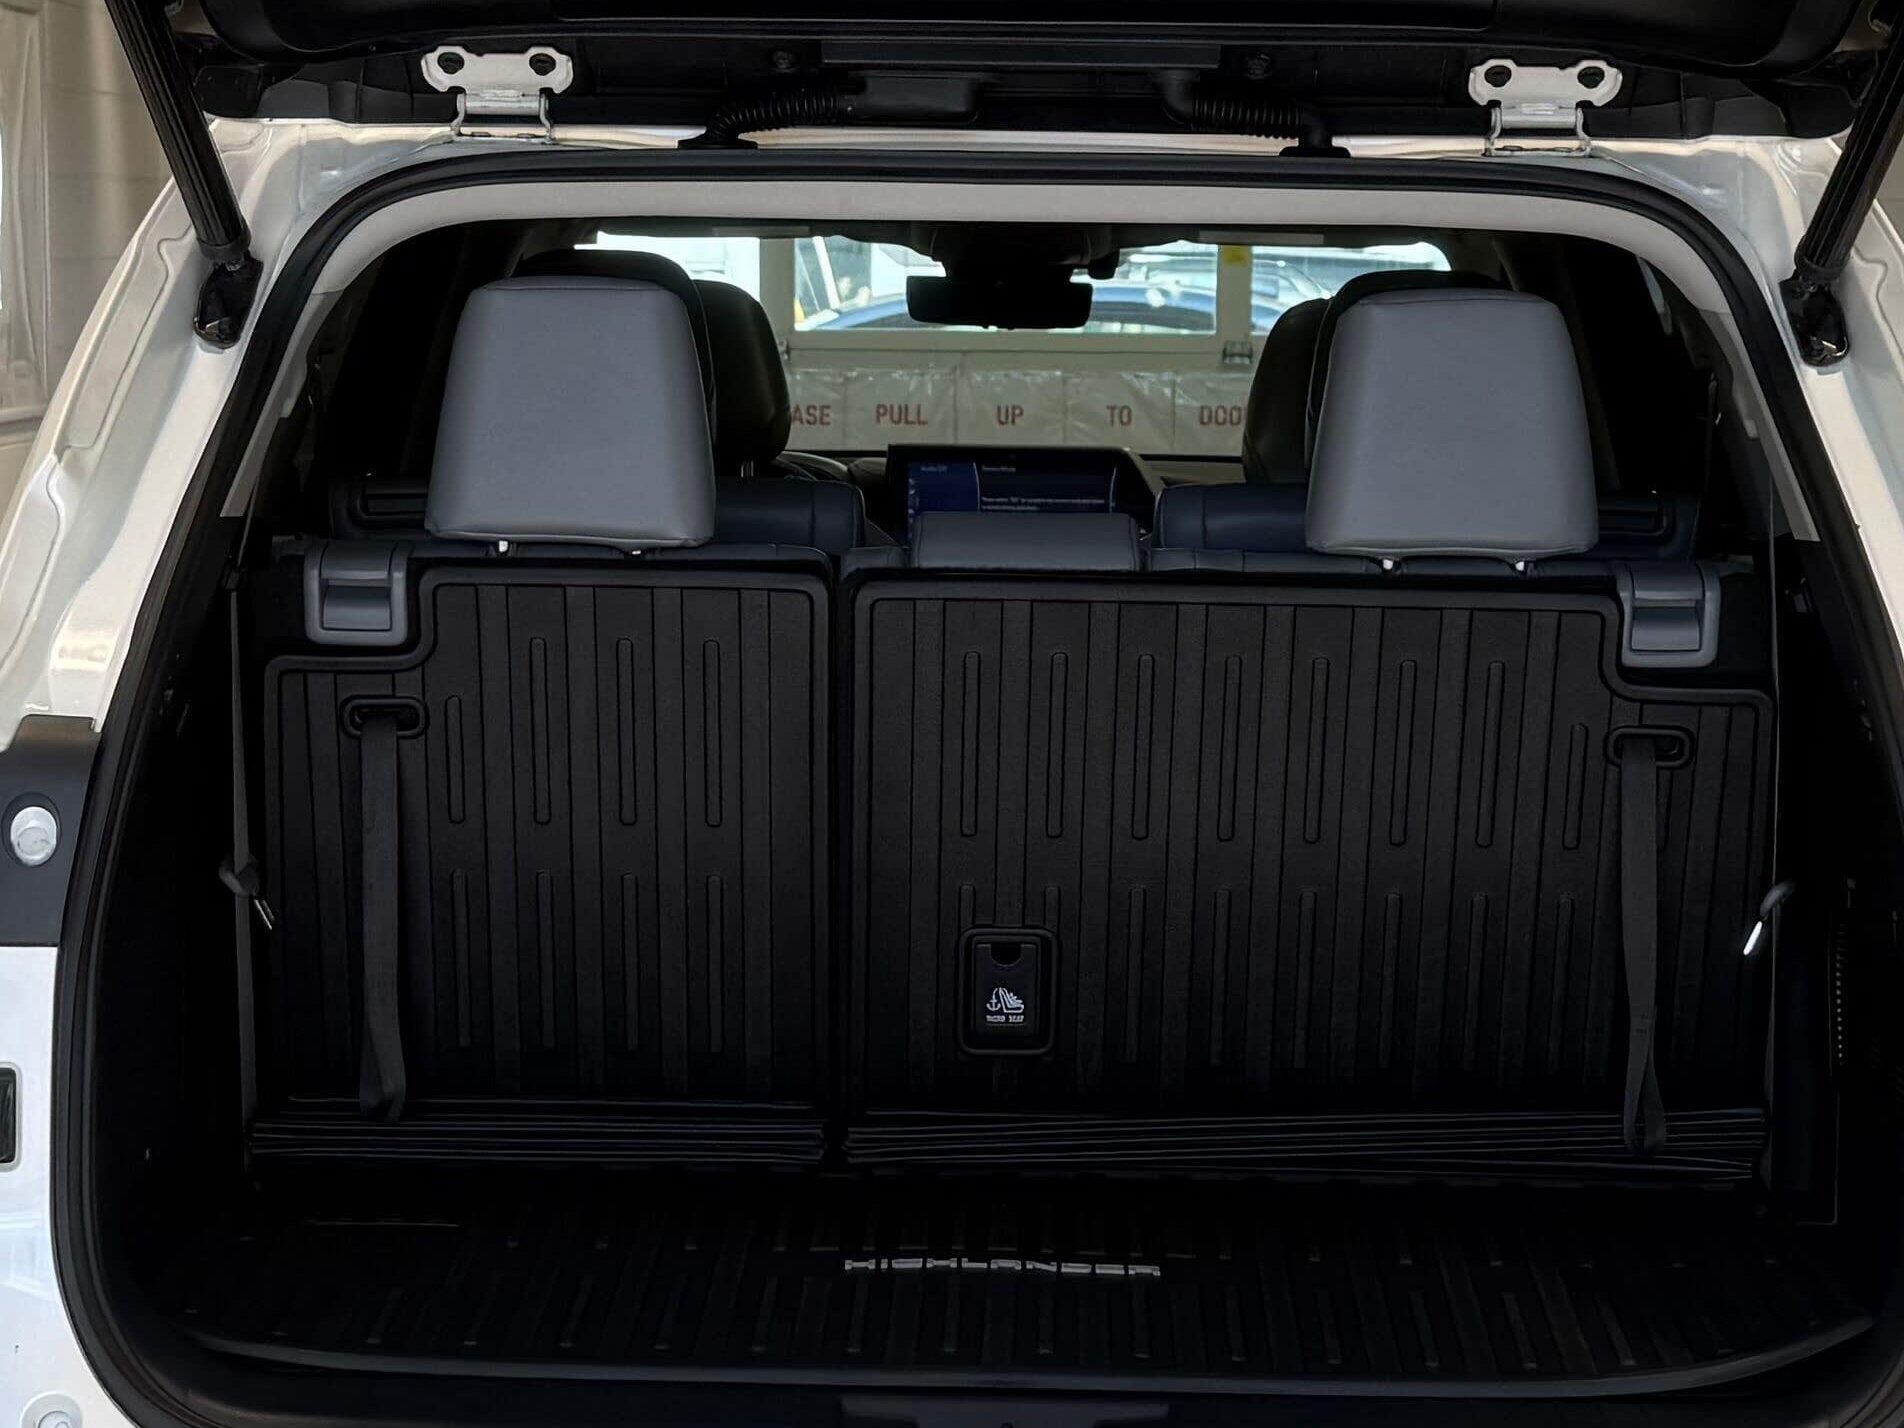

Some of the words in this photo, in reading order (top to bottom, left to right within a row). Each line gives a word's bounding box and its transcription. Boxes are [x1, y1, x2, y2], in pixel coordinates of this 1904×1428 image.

[791, 404, 832, 426] ASE
[875, 404, 929, 426] PULL
[996, 404, 1024, 426] UP
[1106, 405, 1133, 426] TO
[1199, 404, 1248, 426] DOO
